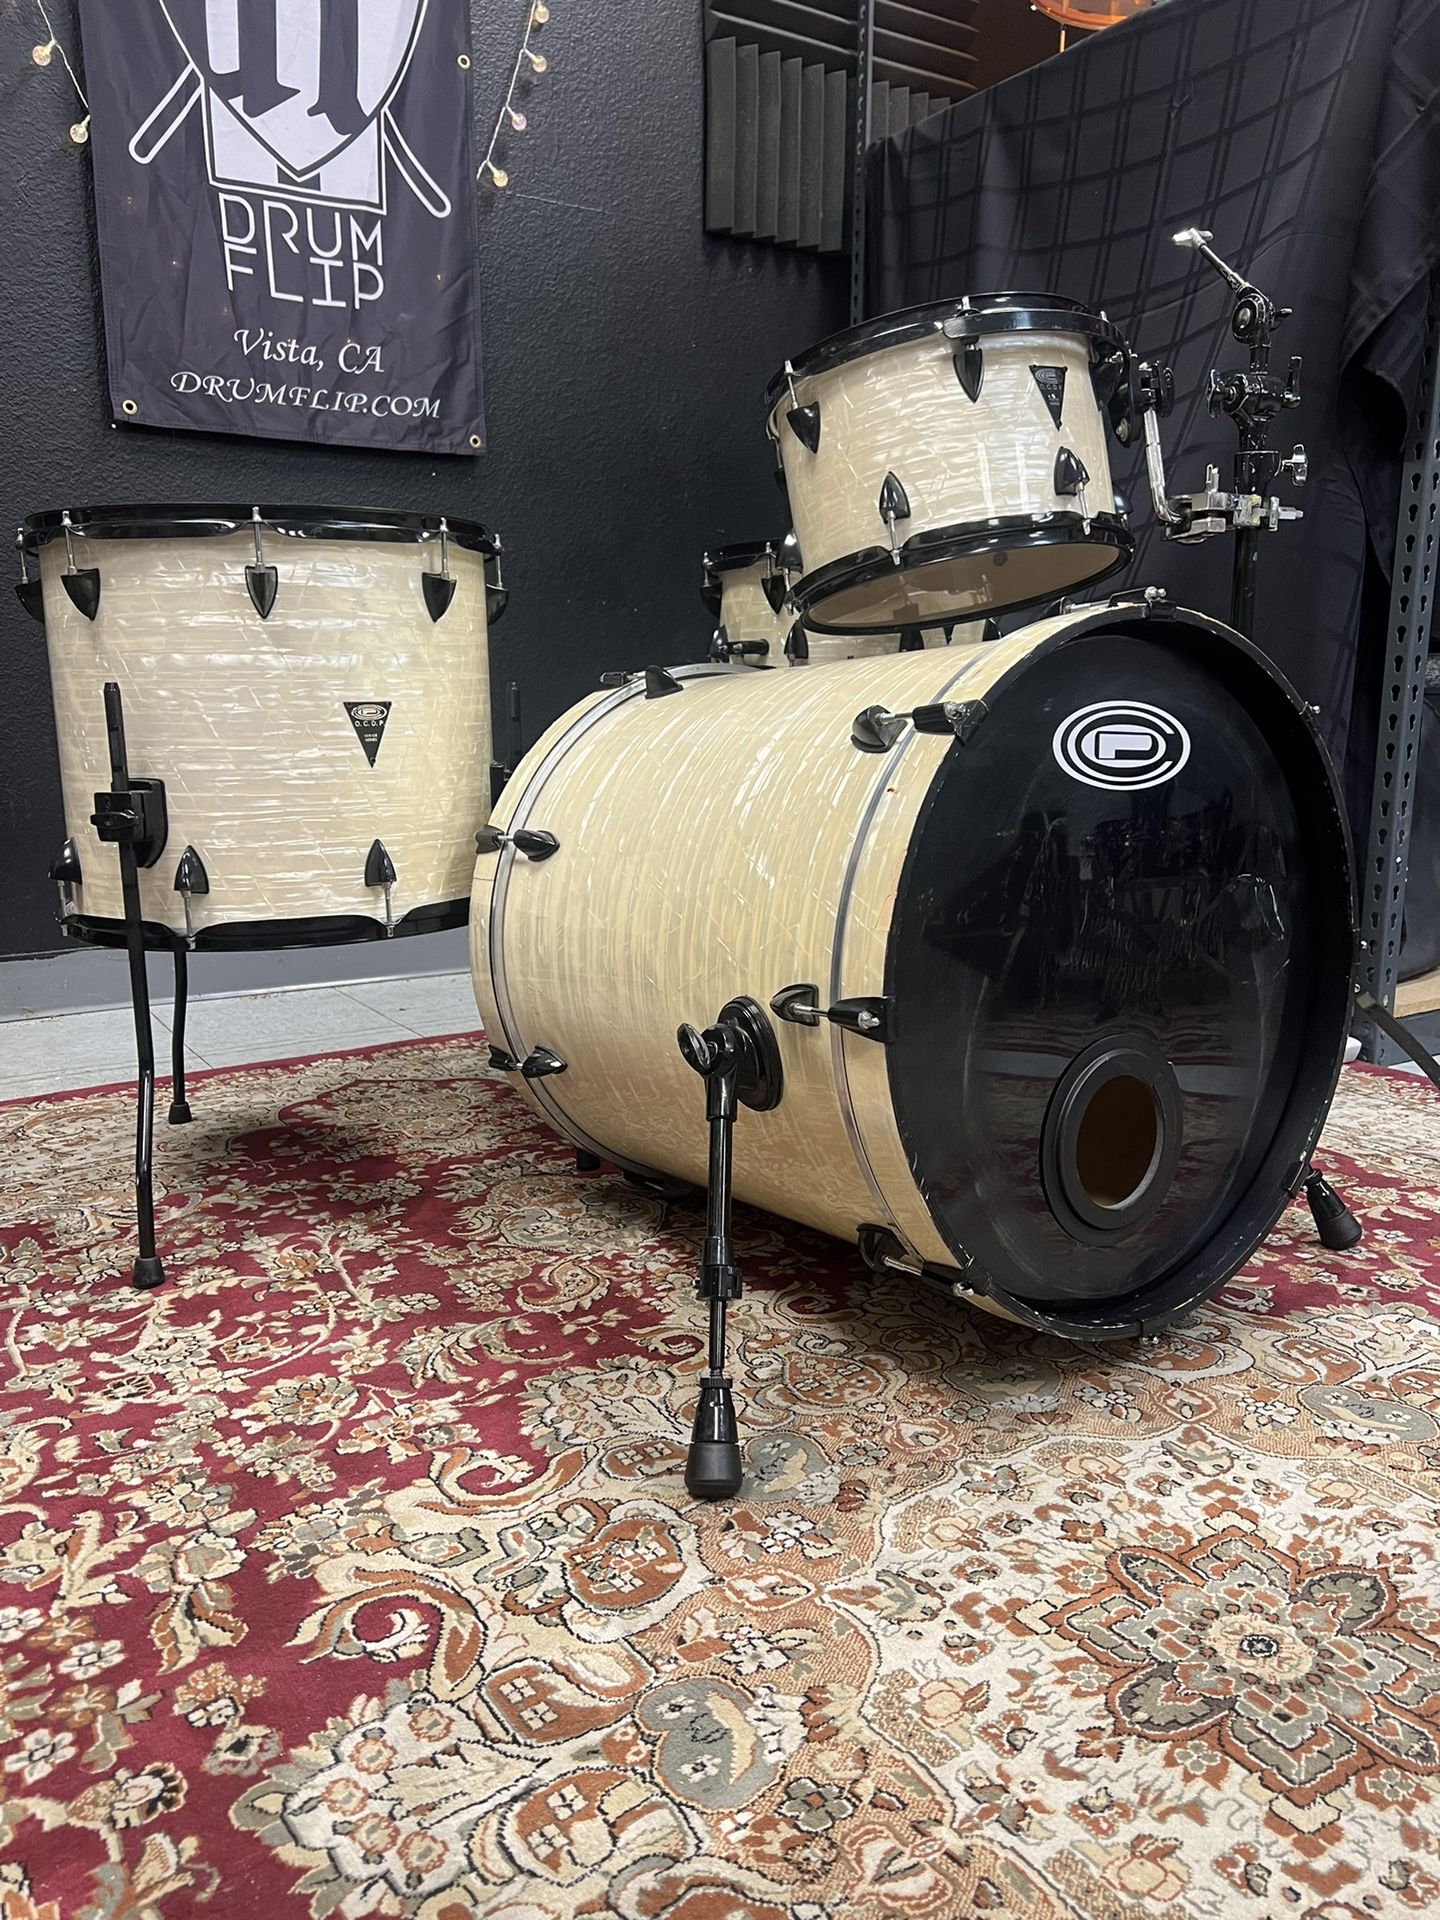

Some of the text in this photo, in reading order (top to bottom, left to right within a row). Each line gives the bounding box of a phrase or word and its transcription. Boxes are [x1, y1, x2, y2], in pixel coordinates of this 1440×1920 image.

[218, 192, 383, 266] DRUM
[223, 241, 385, 310] FLIP
[233, 329, 385, 374] Vista, CA
[170, 371, 441, 418] DRUMFLIP.COM
